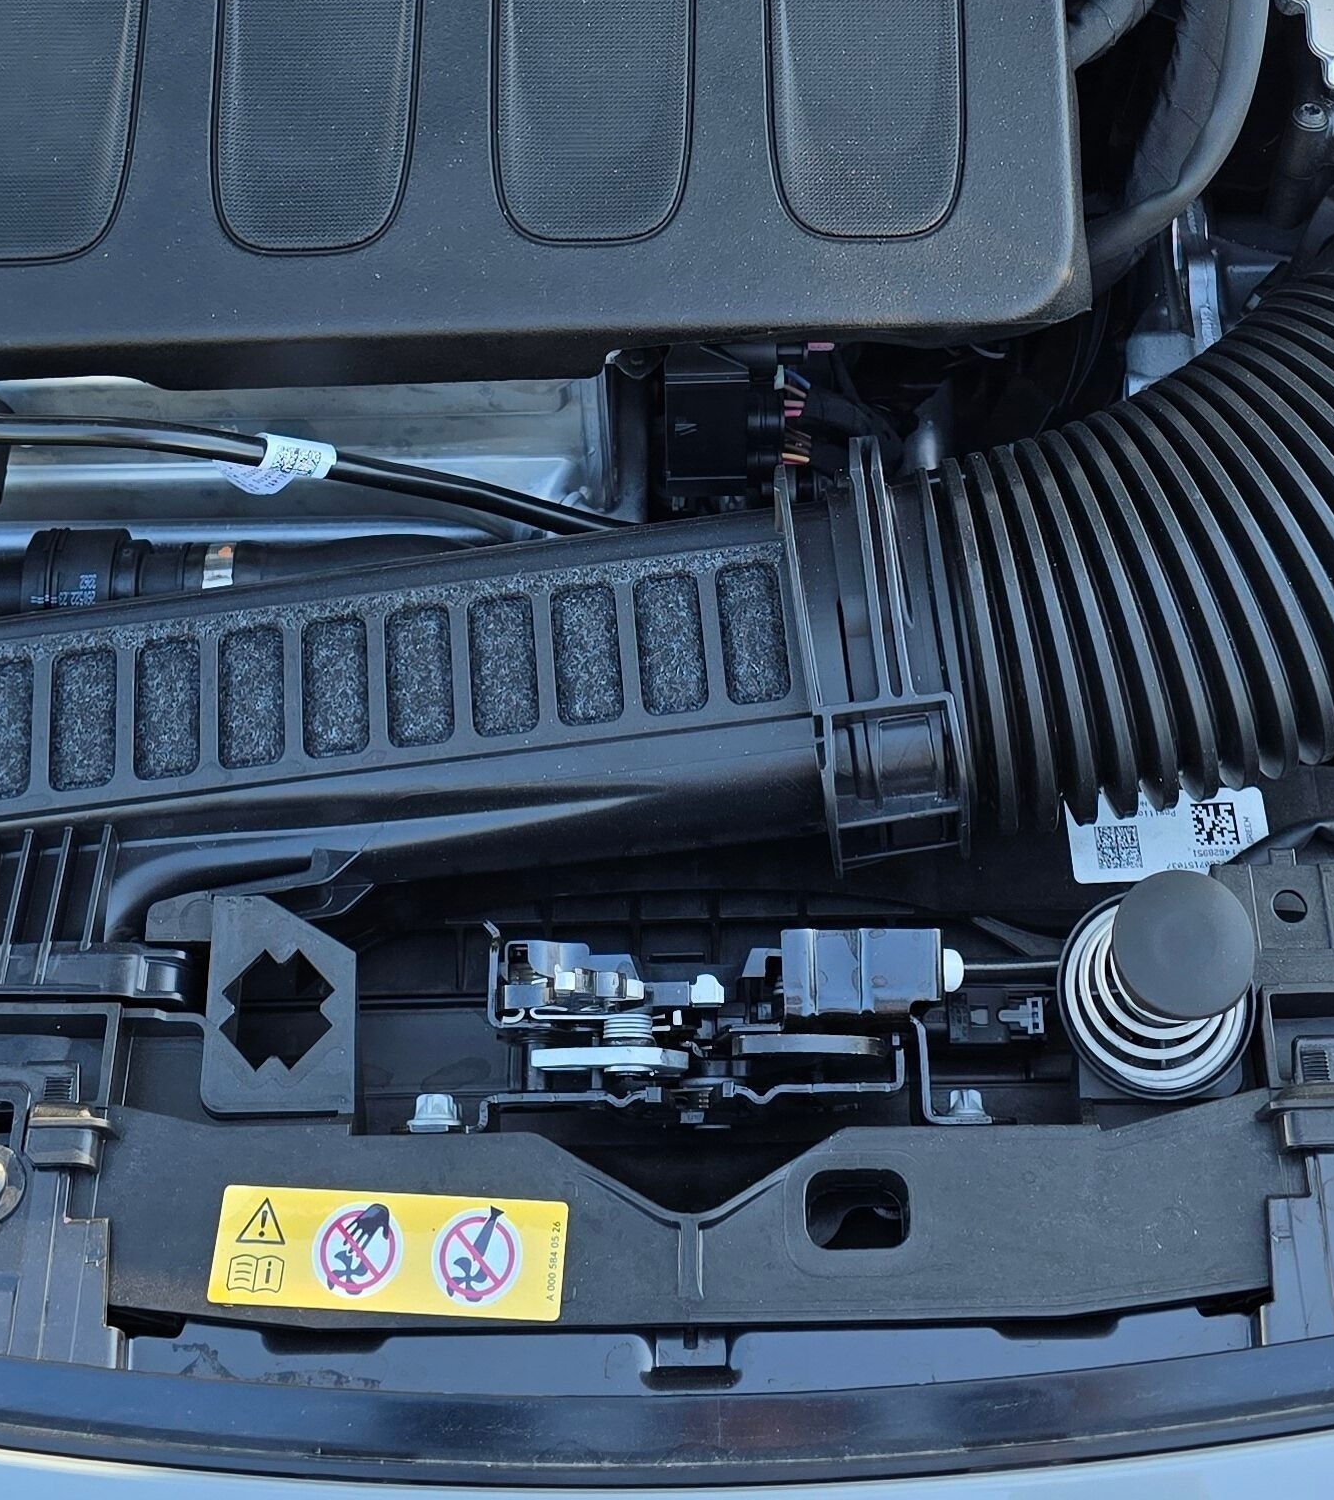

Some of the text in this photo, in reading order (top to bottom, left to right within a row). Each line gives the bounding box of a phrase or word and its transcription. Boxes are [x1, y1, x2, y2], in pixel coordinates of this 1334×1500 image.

[546, 1220, 561, 1302] A 000 584 05 26
